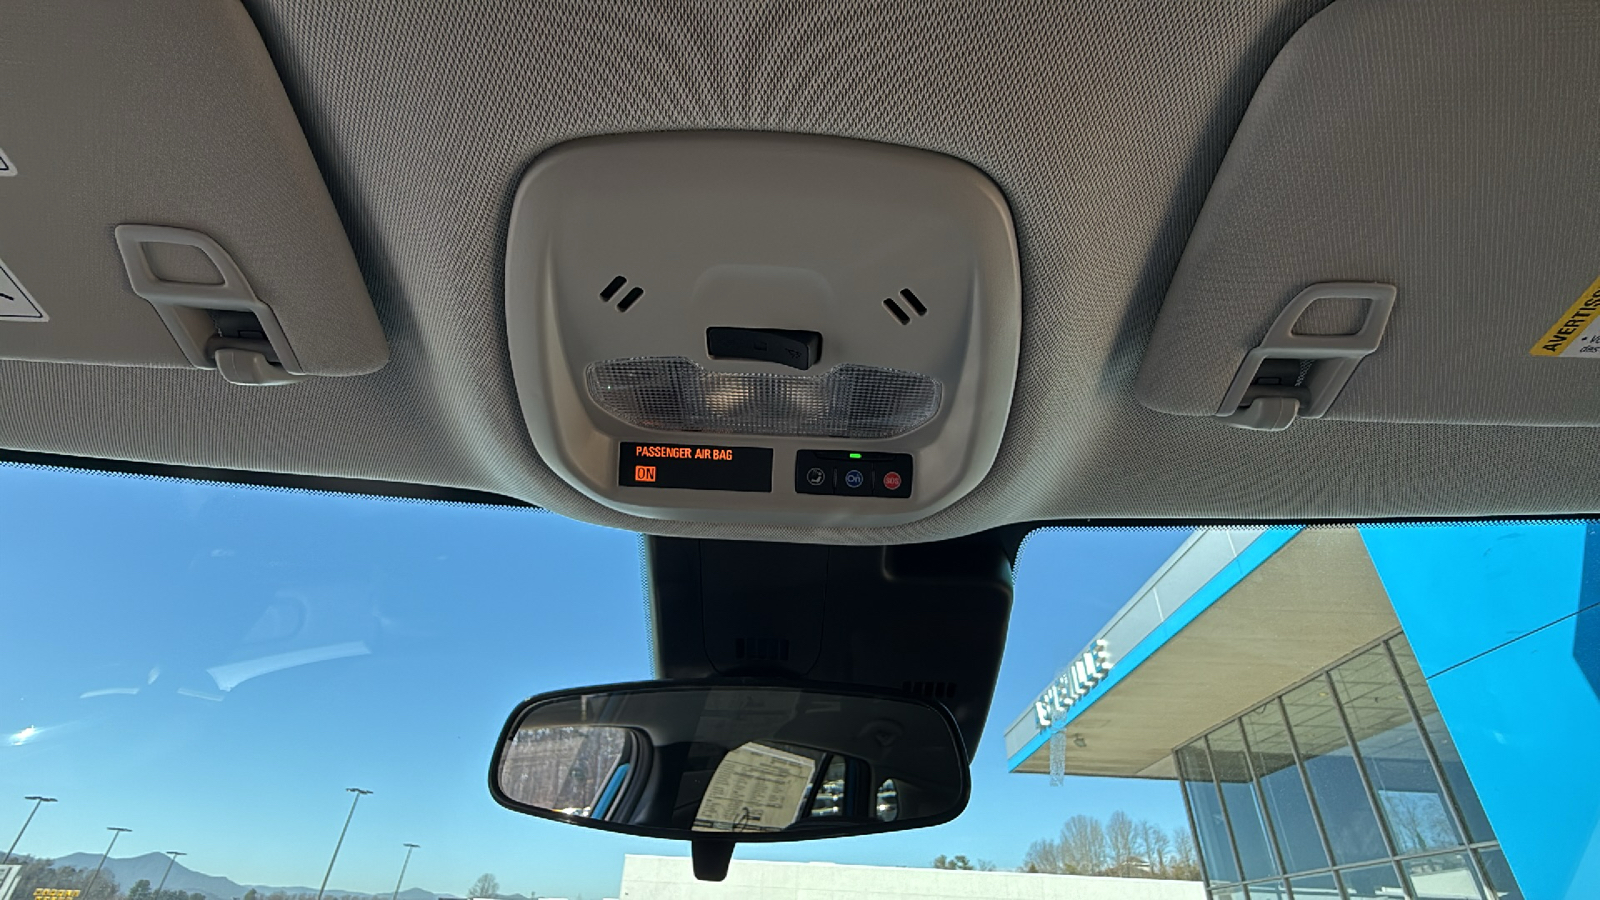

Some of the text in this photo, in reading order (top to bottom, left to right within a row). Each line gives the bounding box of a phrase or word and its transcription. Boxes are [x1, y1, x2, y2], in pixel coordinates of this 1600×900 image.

[636, 446, 733, 461] PASSENGER AIR BAG
[637, 467, 655, 480] ON
